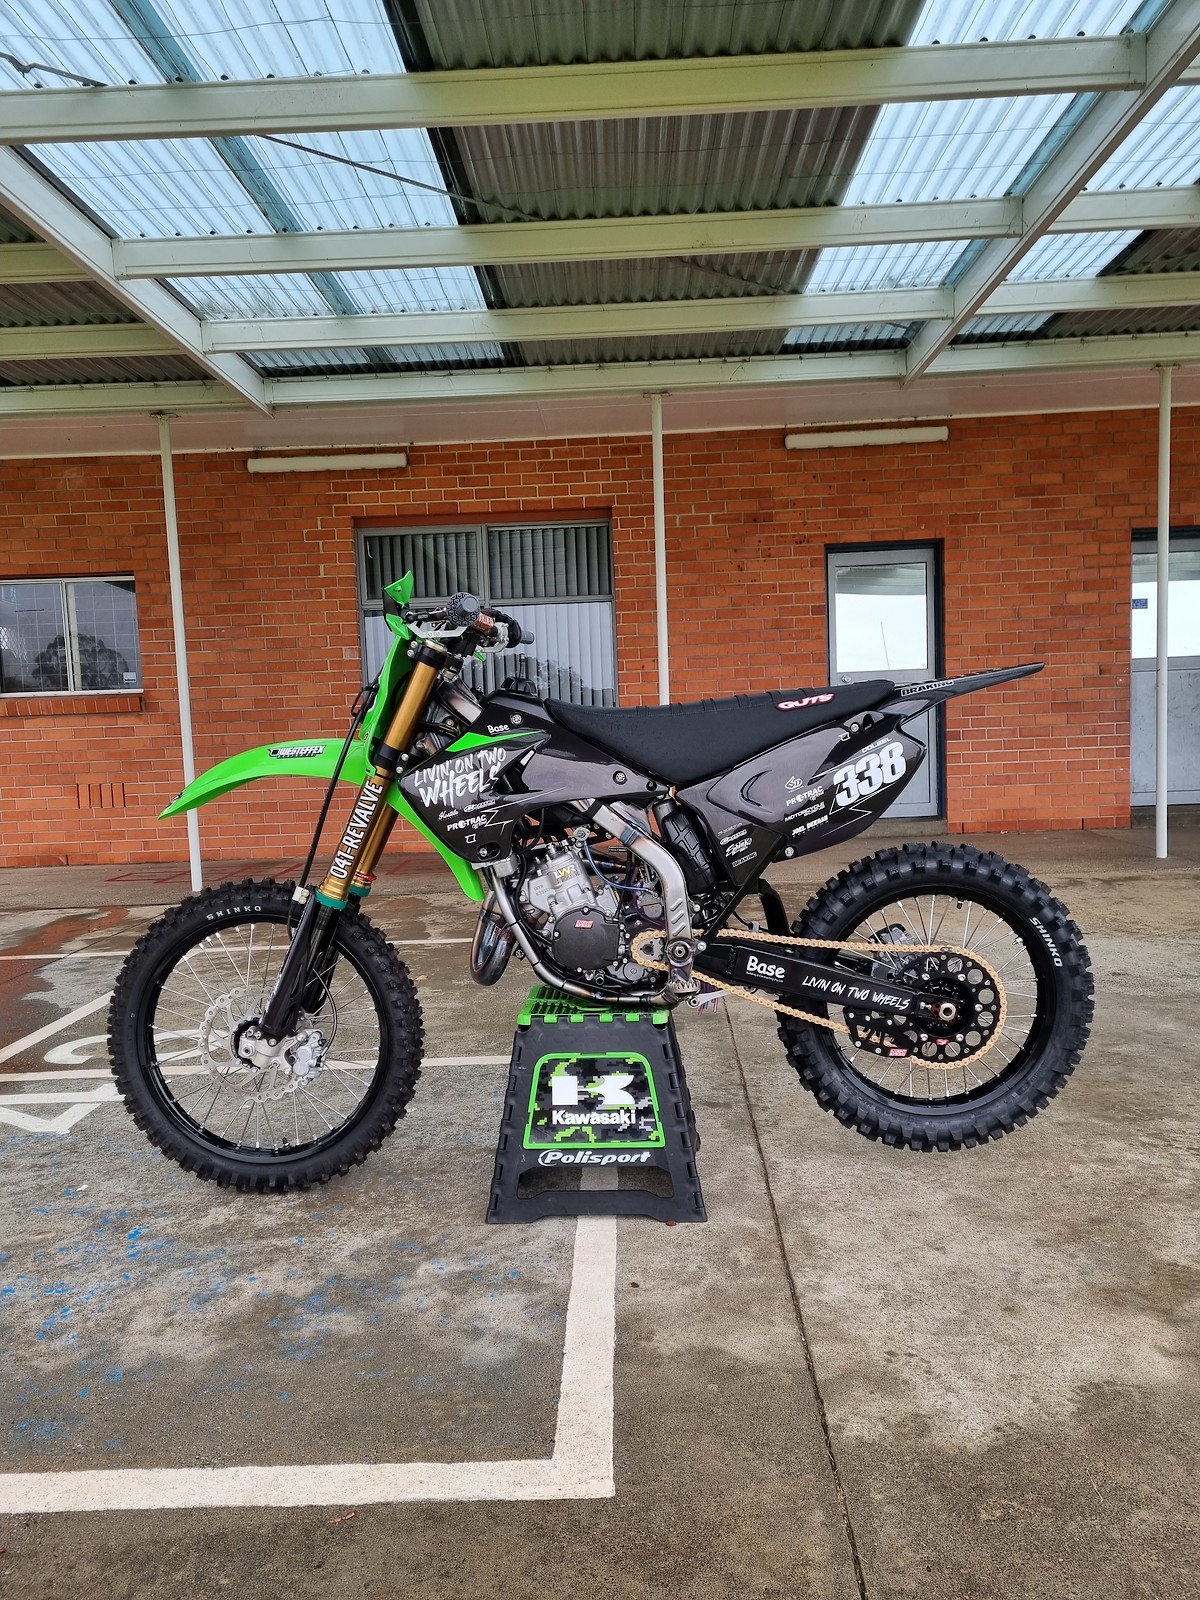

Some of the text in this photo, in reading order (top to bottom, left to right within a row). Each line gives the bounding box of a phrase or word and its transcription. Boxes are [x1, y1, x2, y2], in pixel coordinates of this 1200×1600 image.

[778, 693, 834, 710] GUTS
[487, 724, 510, 735] Base
[455, 756, 474, 774] ON
[477, 747, 507, 765] TWO
[418, 762, 501, 808] WHEELS
[833, 741, 907, 807] 338
[330, 779, 384, 879] 041-REVALVE
[206, 905, 262, 921] SHINKO
[1029, 916, 1063, 967] SHINKO
[746, 955, 786, 979] Base
[801, 975, 831, 992] LIVIN
[831, 981, 847, 997] ON
[848, 986, 870, 1001] TWO
[872, 991, 911, 1011] WHEELS
[552, 1110, 636, 1125] Kawasaki
[542, 1151, 651, 1166] Polisport
